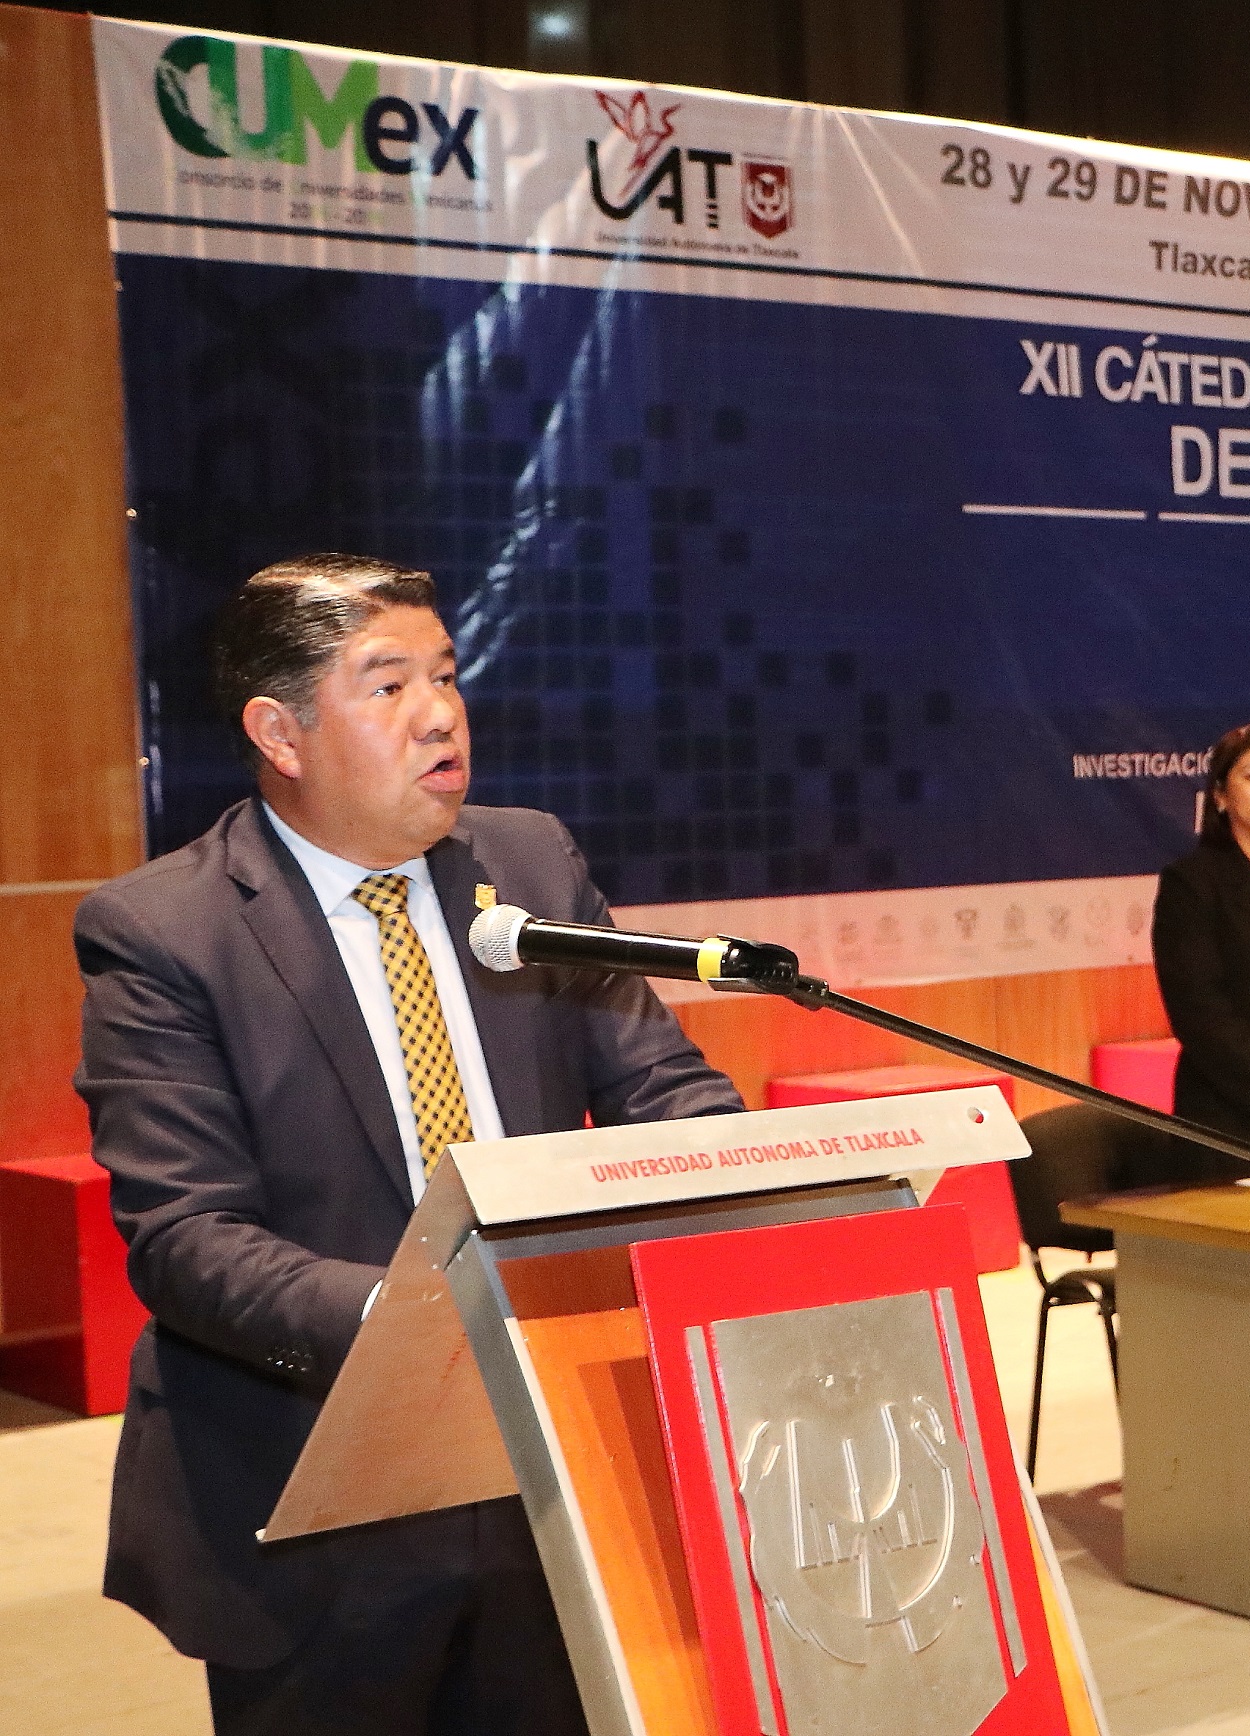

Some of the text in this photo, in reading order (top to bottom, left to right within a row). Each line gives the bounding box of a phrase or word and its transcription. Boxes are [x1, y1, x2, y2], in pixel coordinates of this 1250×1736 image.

[940, 143, 992, 189] 28
[1007, 161, 1031, 205] y
[1046, 156, 1098, 202] 29
[1113, 165, 1168, 211] DE
[1020, 339, 1083, 398] XII
[590, 1128, 925, 1183] UNIVERSIDAD AUTONOMA DE TLAXCALA
